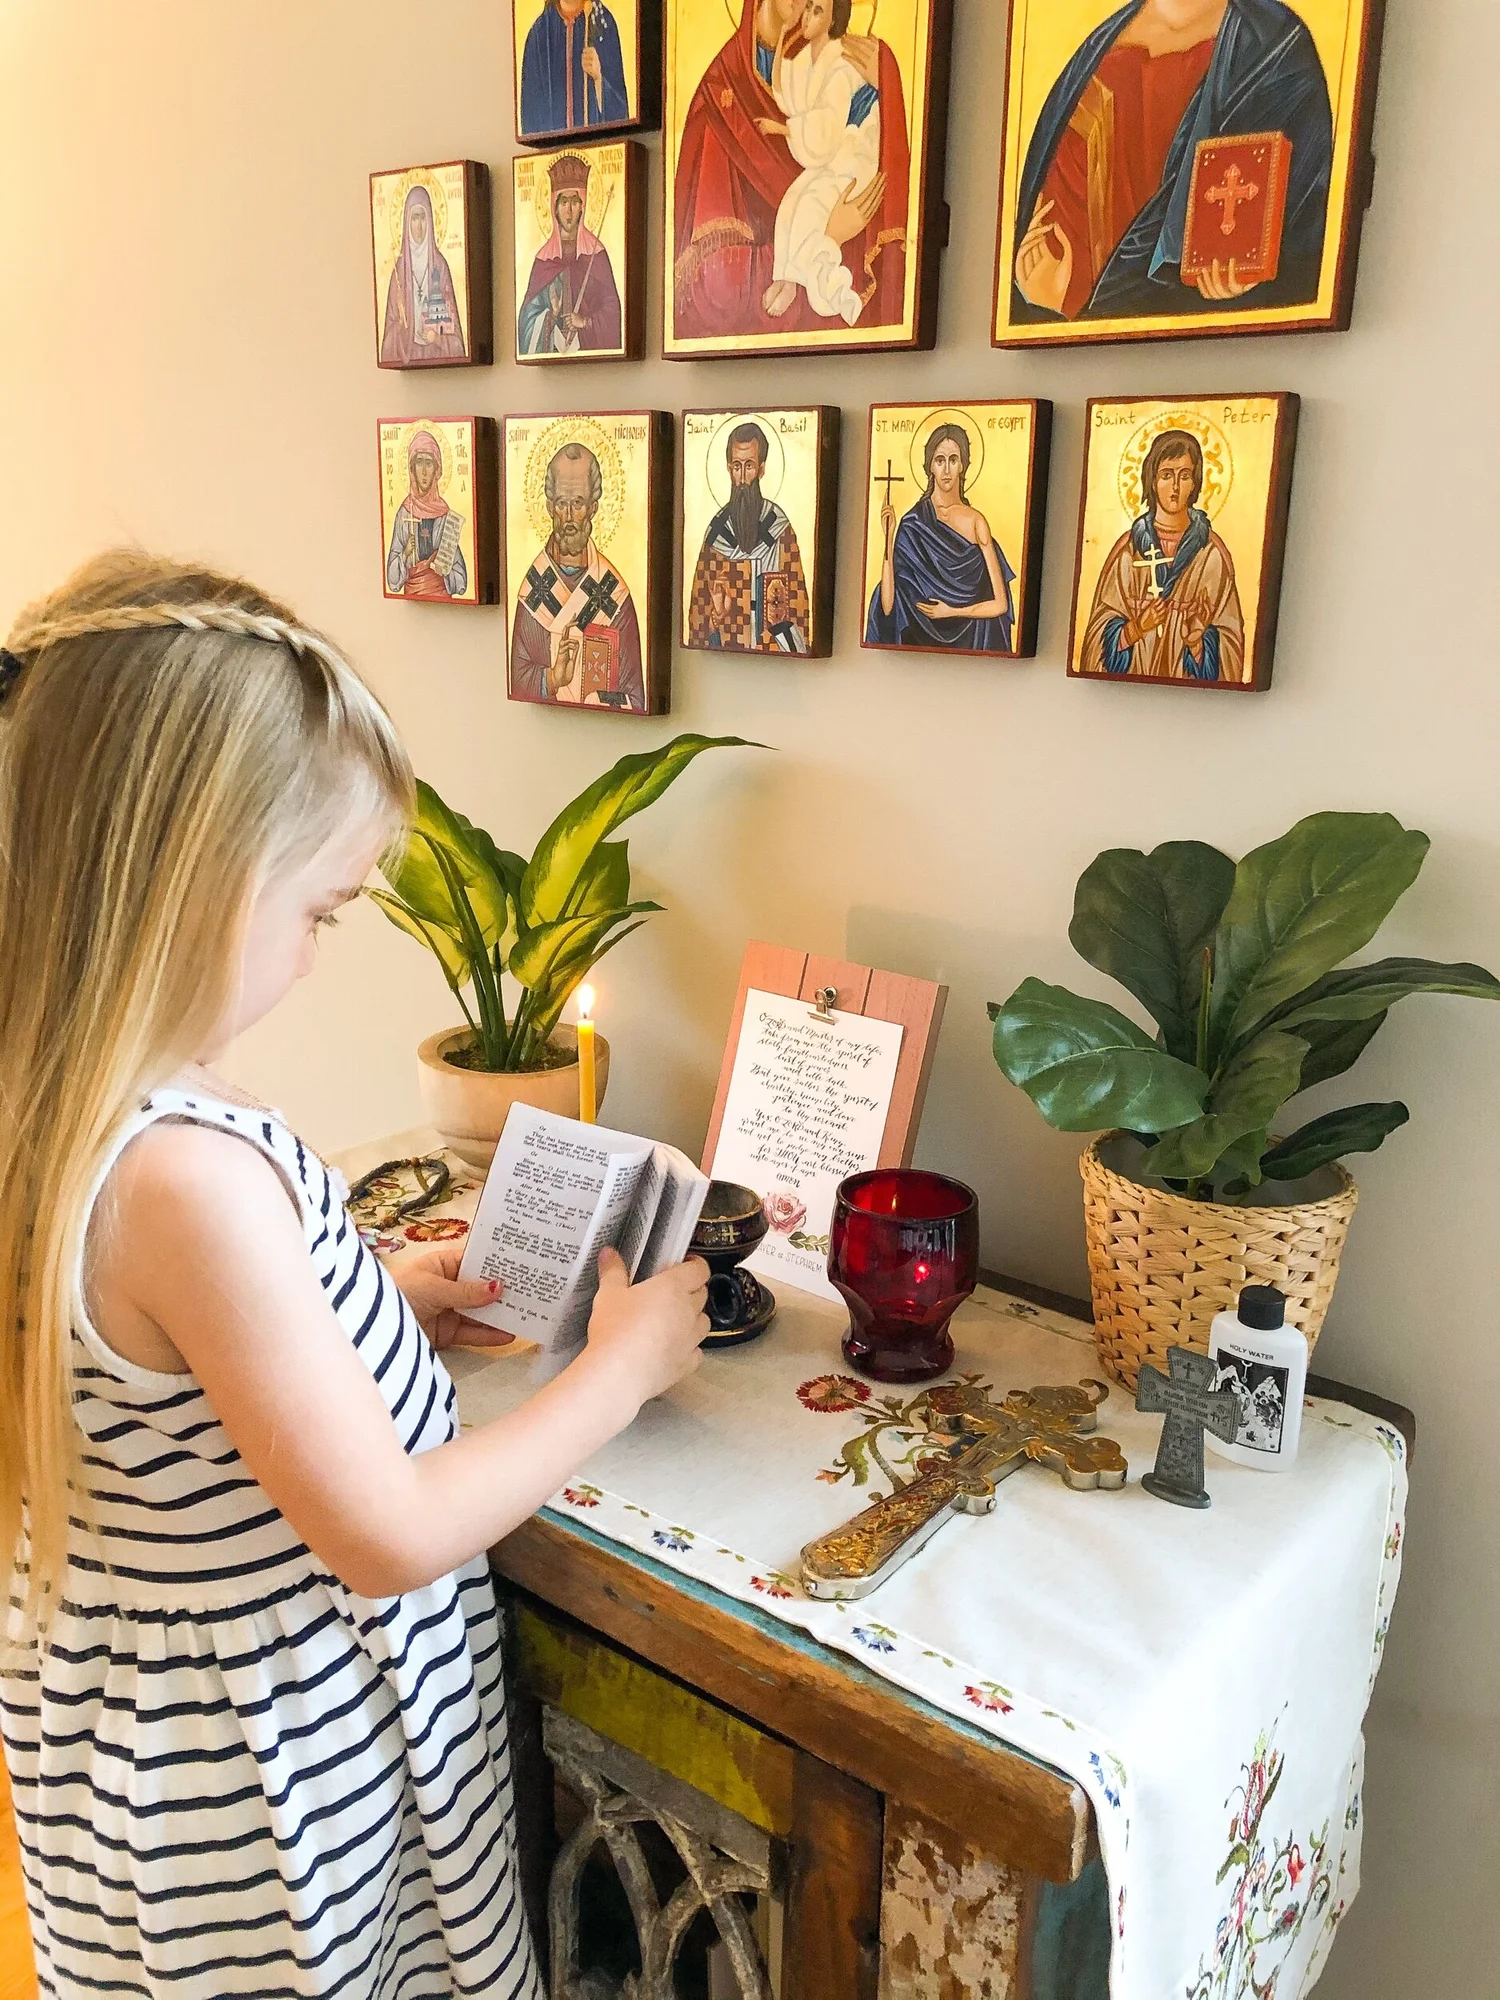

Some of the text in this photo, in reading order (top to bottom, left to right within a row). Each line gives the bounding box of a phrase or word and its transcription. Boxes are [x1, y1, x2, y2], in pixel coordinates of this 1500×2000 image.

[892, 419, 916, 433] MARY
[987, 418, 997, 430] OF
[998, 417, 1026, 432] EGYPT
[1095, 406, 1271, 427] Saint Peter
[687, 417, 807, 434] Saint Basil
[1229, 1344, 1274, 1361] HOLY WATER
